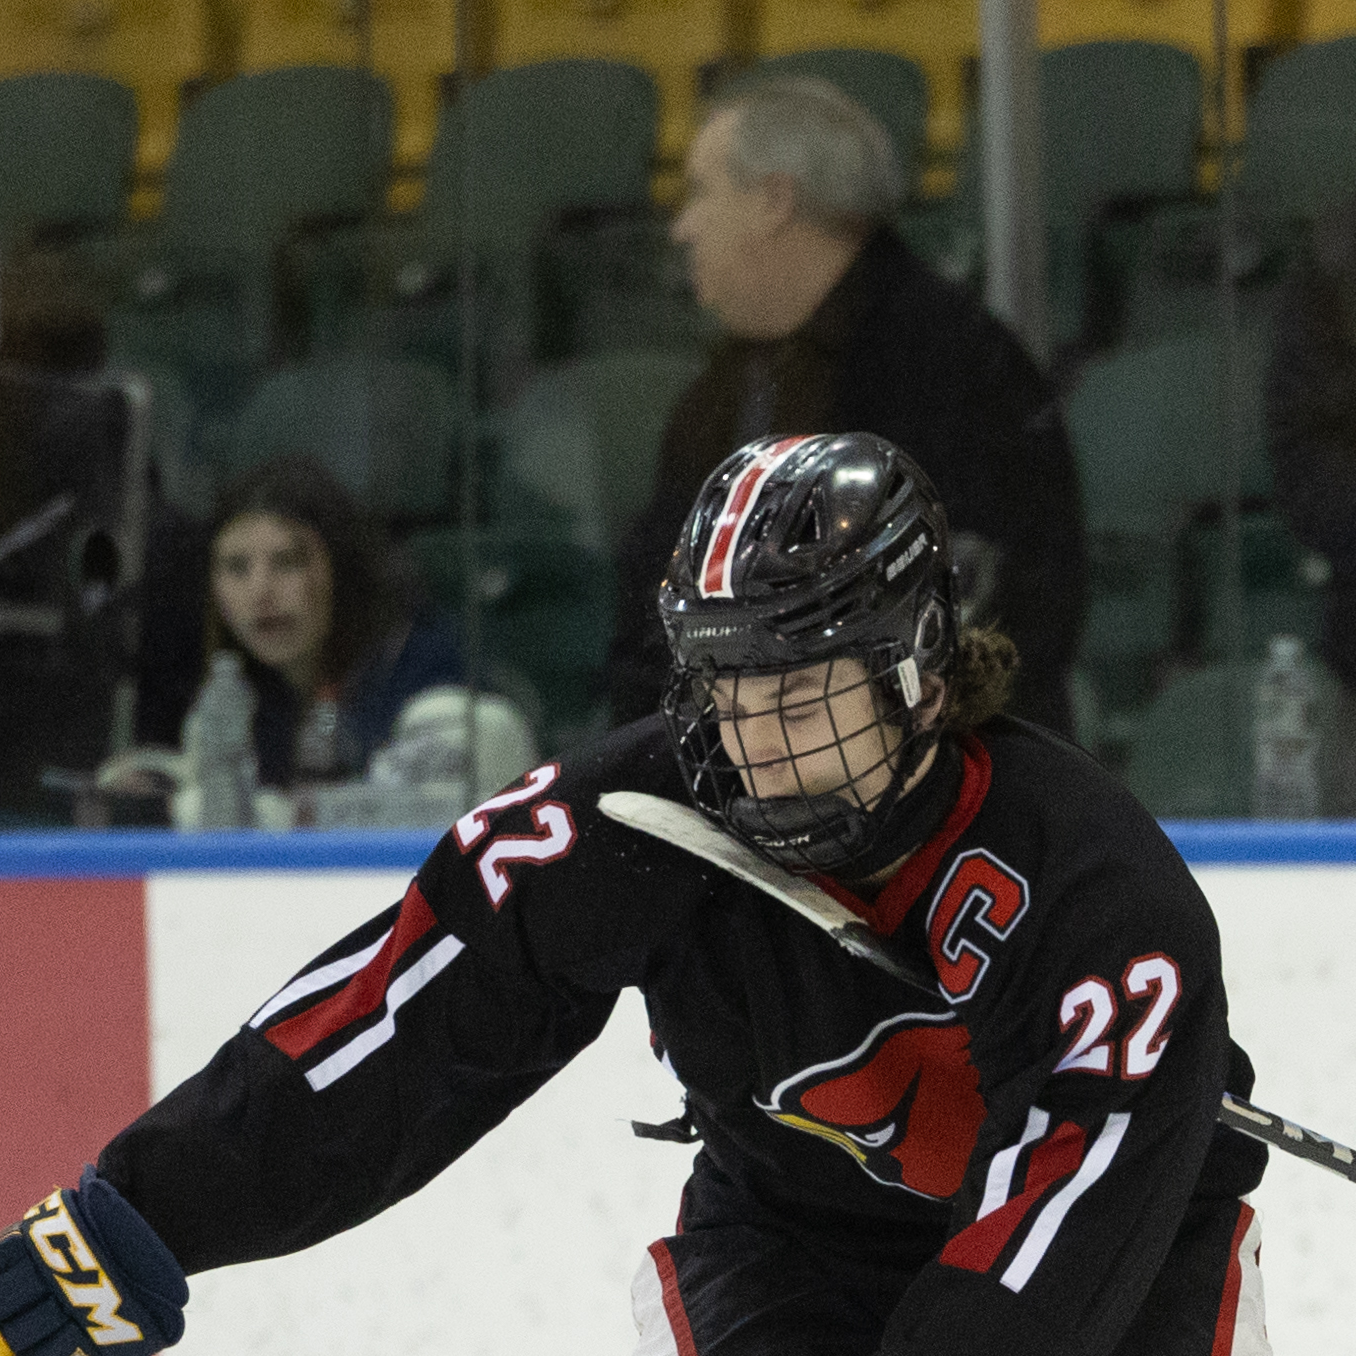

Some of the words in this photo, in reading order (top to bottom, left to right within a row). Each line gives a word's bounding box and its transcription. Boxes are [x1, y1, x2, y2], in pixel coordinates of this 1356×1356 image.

[452, 761, 578, 913] 22
[926, 847, 1030, 1005] C
[1051, 951, 1183, 1080] 22
[23, 1185, 144, 1346] CCM
